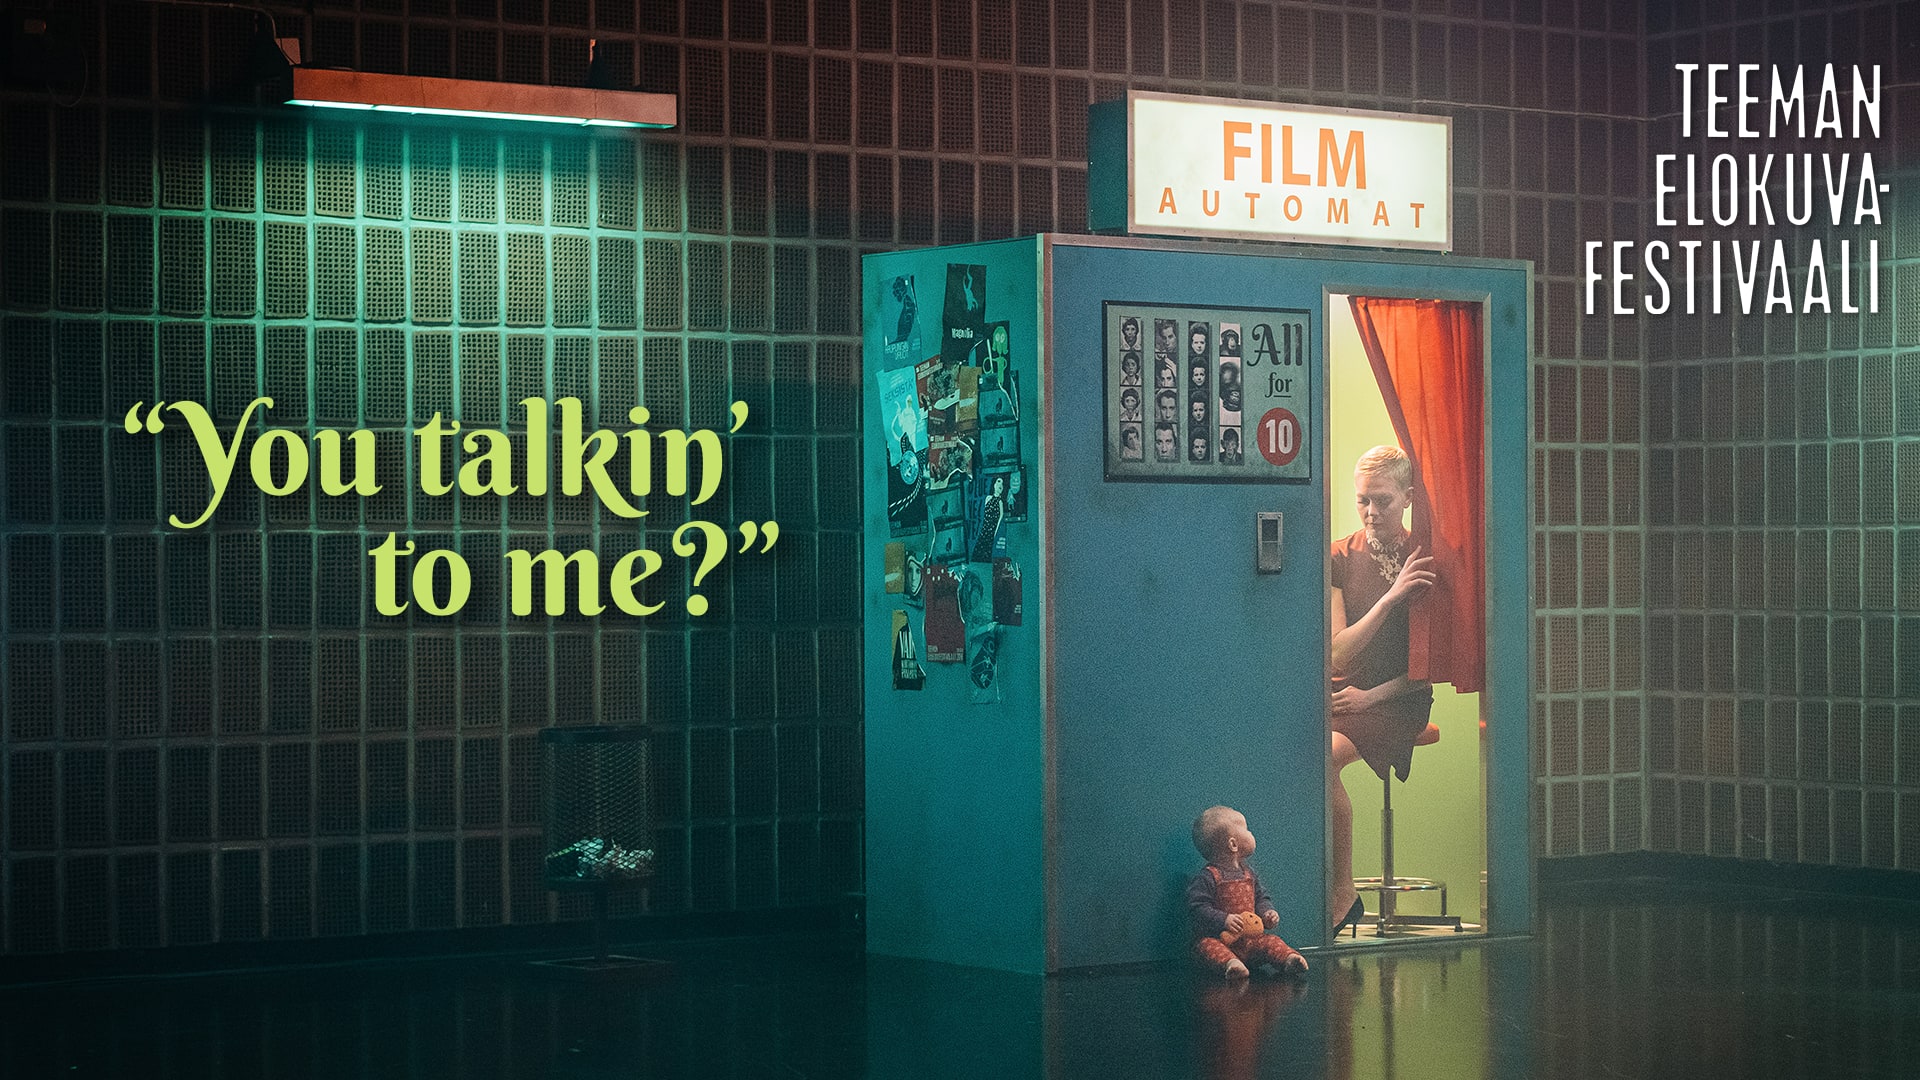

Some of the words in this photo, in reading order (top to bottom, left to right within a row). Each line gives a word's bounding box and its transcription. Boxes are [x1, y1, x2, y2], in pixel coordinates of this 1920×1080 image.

[1222, 120, 1367, 190] FILM
[1158, 187, 1425, 229] AUTOMAT
[1246, 322, 1303, 367] All
[1264, 371, 1293, 398] for
[1265, 418, 1294, 455] 10
